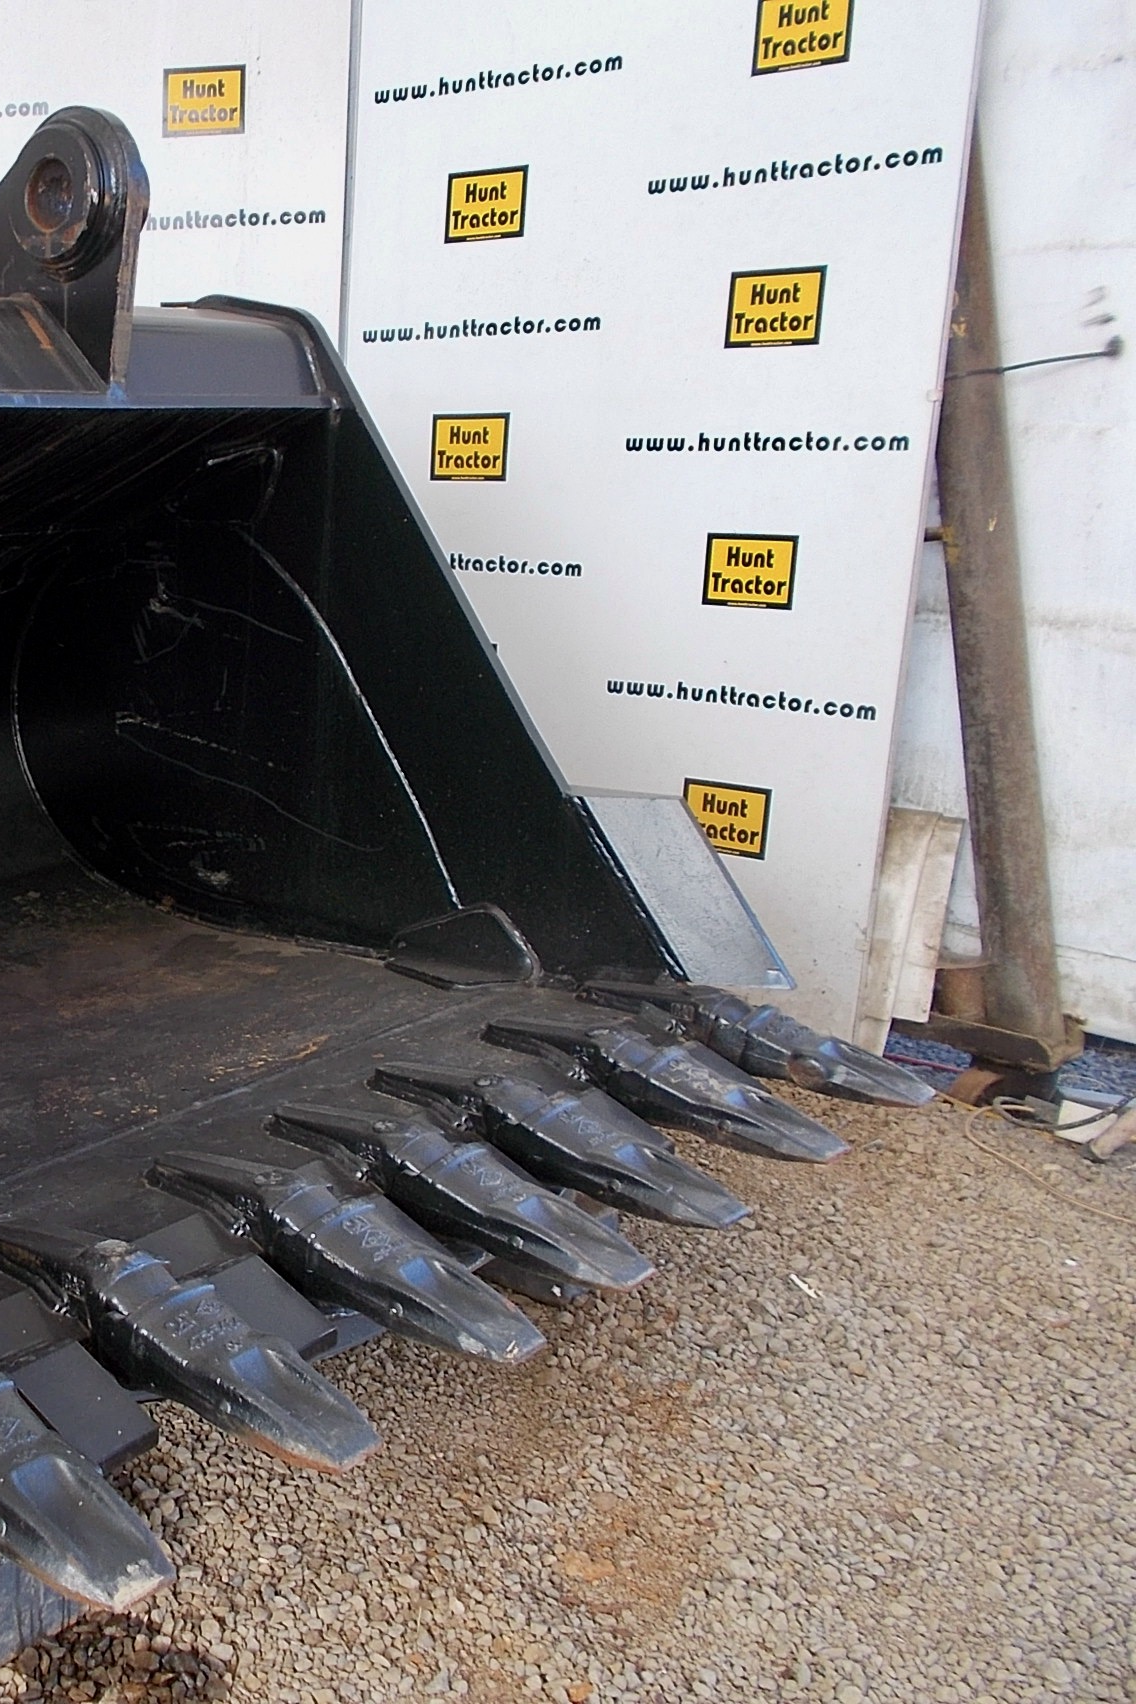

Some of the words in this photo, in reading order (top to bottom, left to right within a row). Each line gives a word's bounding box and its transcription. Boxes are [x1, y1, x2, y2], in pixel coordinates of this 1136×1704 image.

[778, 0, 830, 29] Hunt
[761, 30, 844, 60] Tractor
[182, 78, 225, 98] Hunt
[374, 55, 623, 105] www.hunttractor.com
[170, 104, 239, 124] Tractor
[647, 147, 943, 195] www.hunttractor.com
[464, 181, 507, 204] Hunt
[146, 207, 326, 231] hunttractor.com
[451, 207, 519, 231] Tractor
[750, 282, 801, 306] Hunt
[362, 316, 601, 344] www.hunttractor.com
[734, 311, 814, 335] Tractor
[449, 425, 490, 445] Hunt
[625, 431, 909, 452] www.hunttractor.com
[437, 449, 501, 469] Tractor
[449, 552, 582, 577] ttractor.com
[726, 546, 775, 569] Hunt
[711, 571, 787, 596] Tractor
[606, 680, 876, 721] www.hunttractor.com
[701, 792, 748, 818] Hunt
[698, 820, 760, 845] actor
